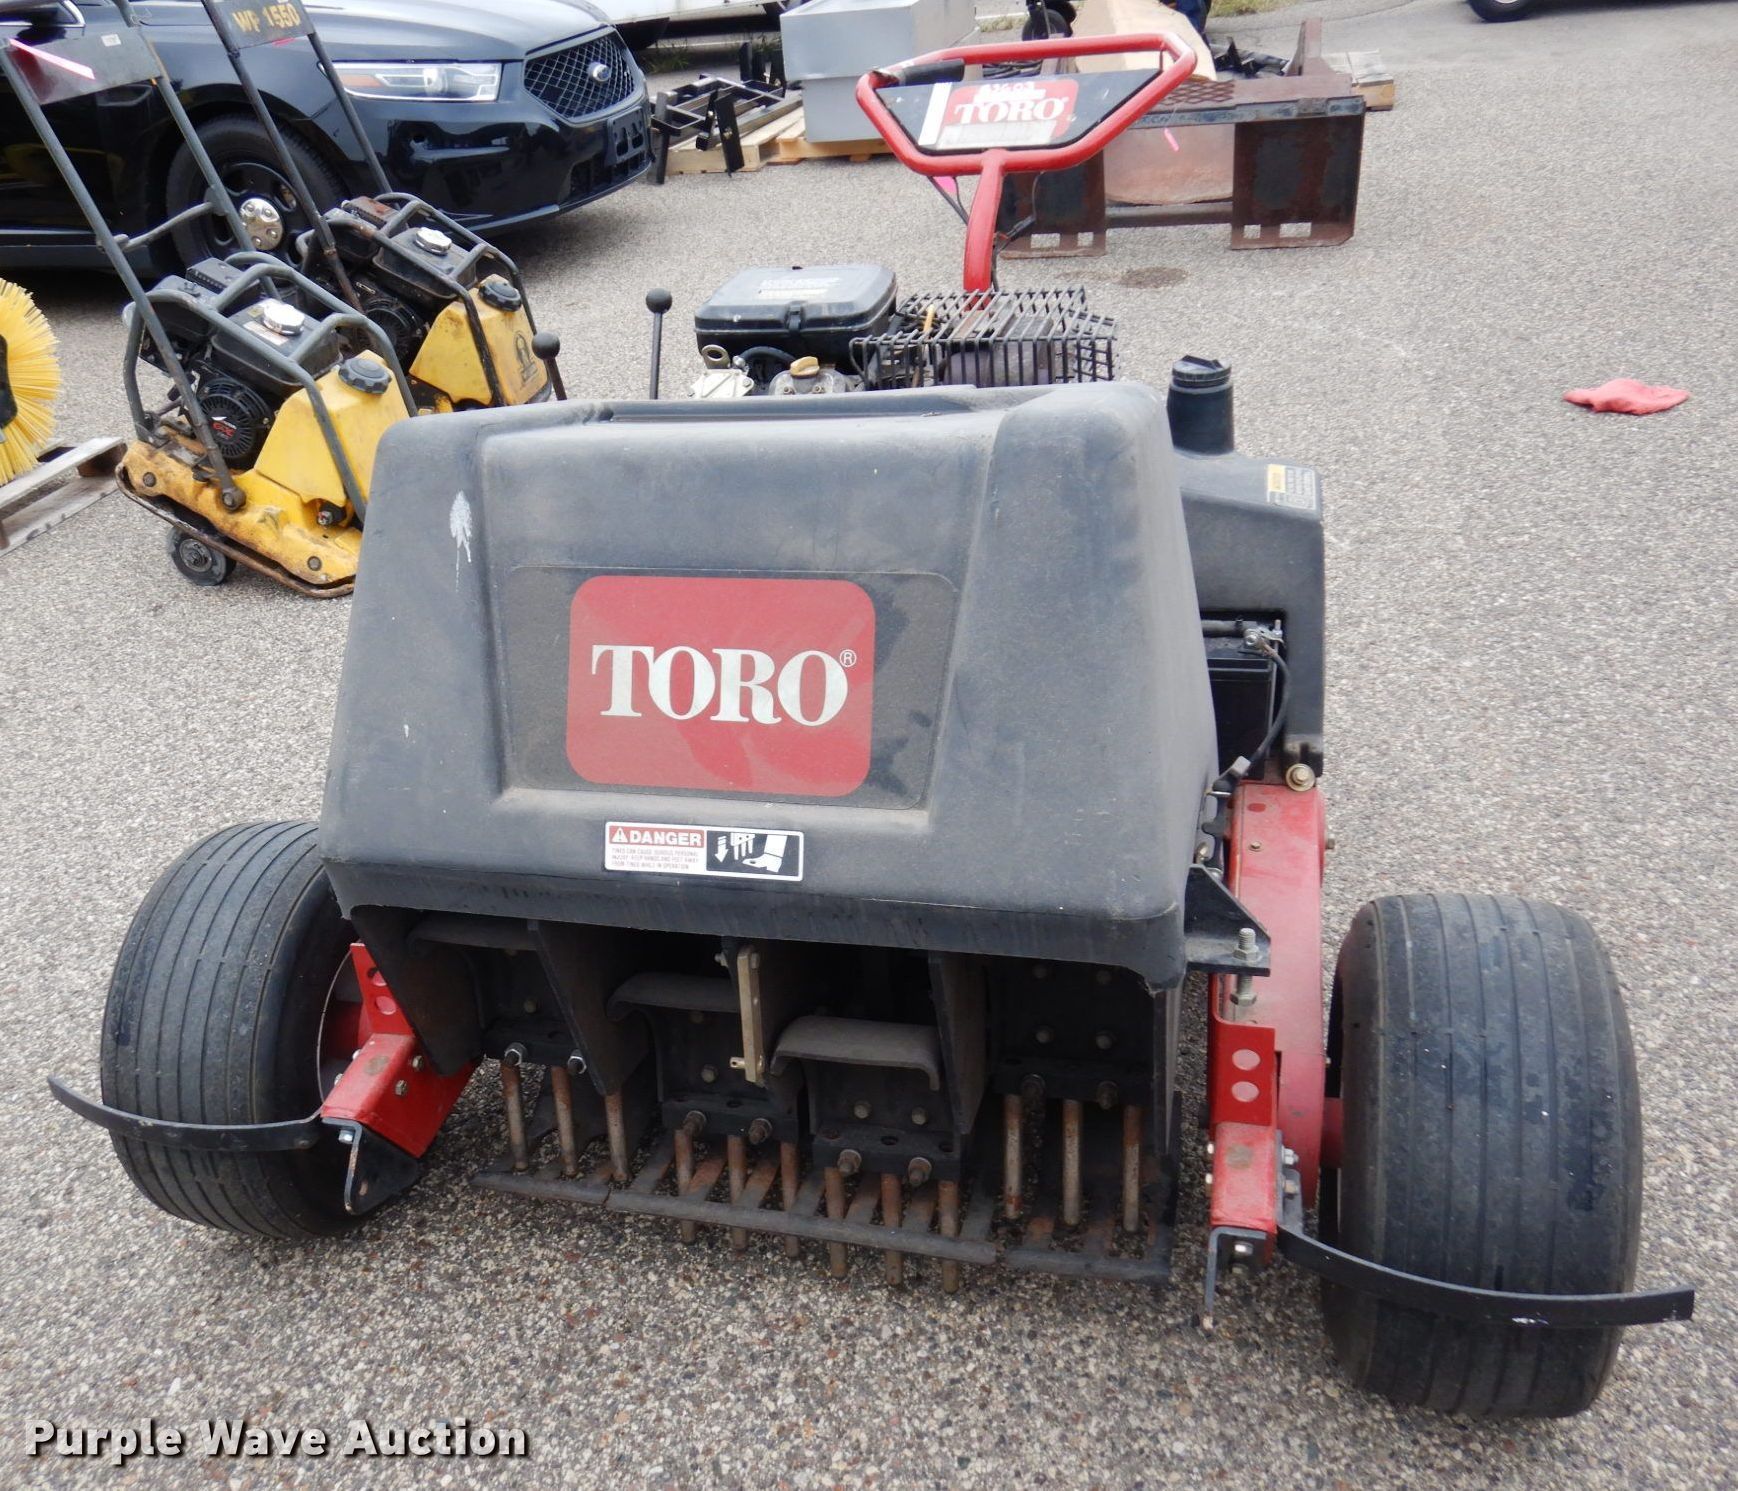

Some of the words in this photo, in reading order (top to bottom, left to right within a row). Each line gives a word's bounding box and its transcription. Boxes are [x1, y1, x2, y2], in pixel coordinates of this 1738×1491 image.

[262, 3, 301, 28] 1550
[954, 97, 1067, 124] TORO
[630, 830, 702, 846] DANGER
